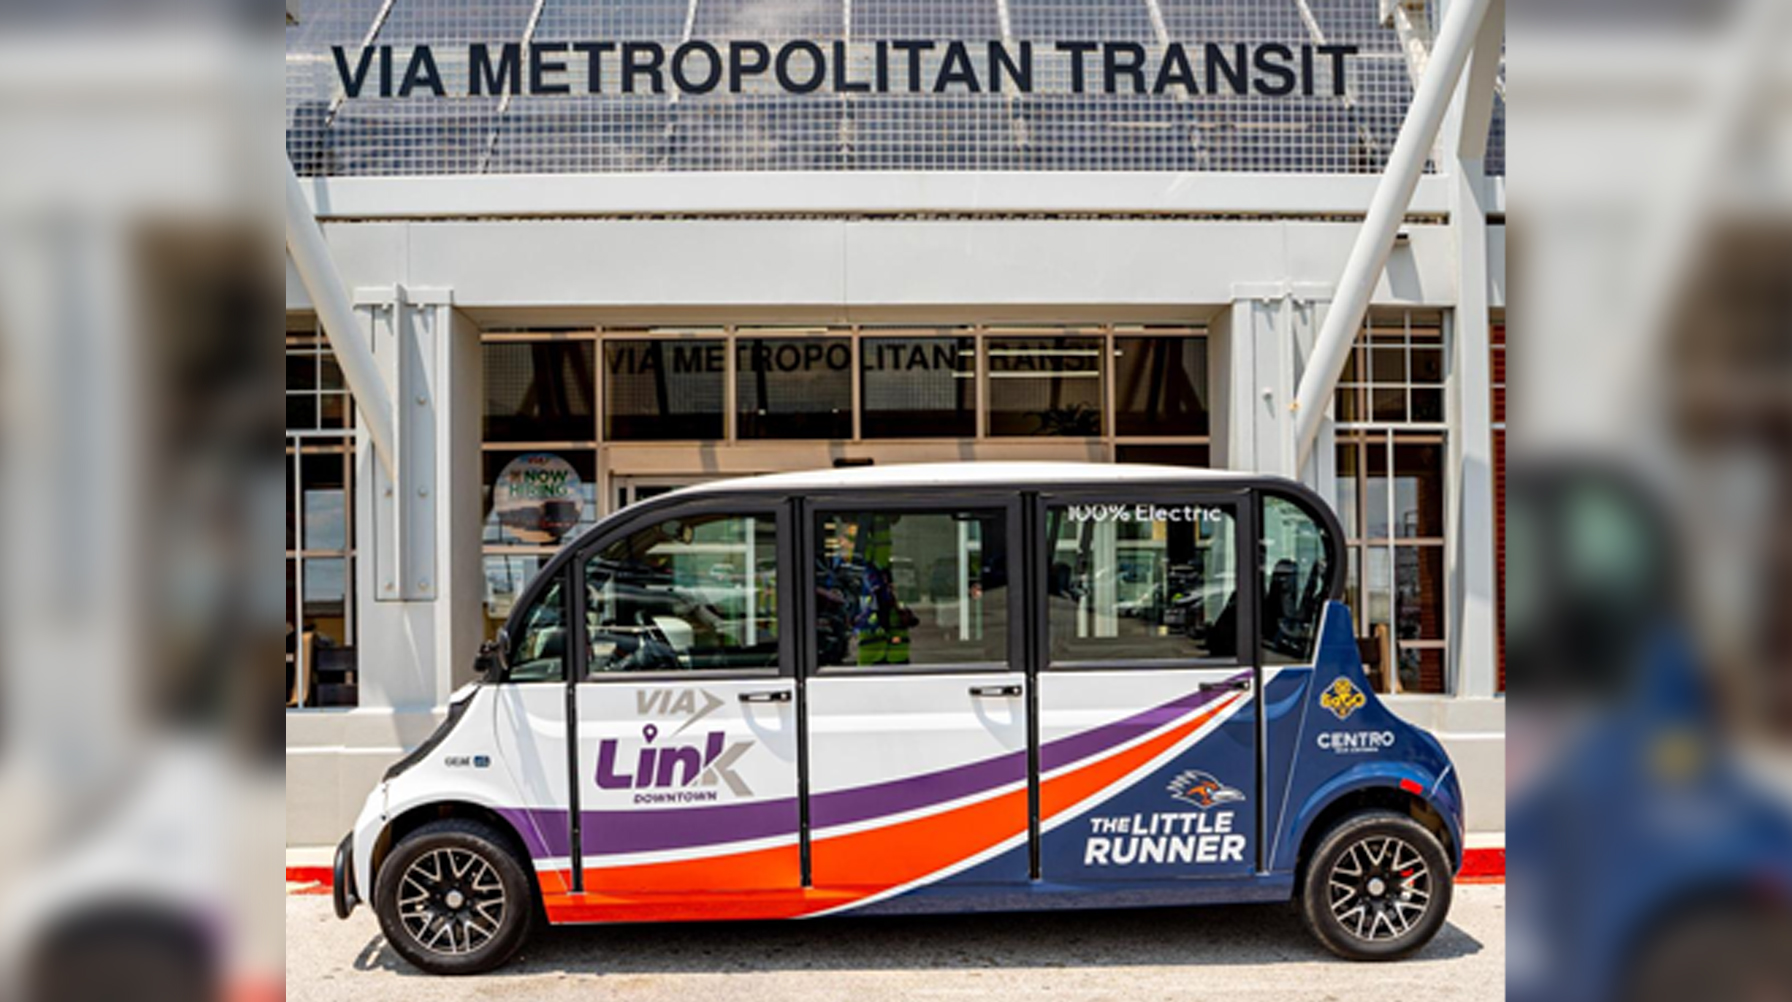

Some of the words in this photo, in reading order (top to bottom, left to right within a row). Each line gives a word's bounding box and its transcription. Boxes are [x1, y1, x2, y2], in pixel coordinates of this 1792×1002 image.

[331, 45, 446, 98] VIA
[468, 40, 1033, 96] METROPOLITAN
[1055, 41, 1359, 97] TRANSIT
[524, 469, 568, 482] NOW
[1067, 503, 1131, 522] 100%
[1135, 503, 1222, 522] Electric
[635, 689, 695, 716] VIA
[1316, 730, 1395, 749] CENTRO
[595, 723, 756, 797] Link
[633, 790, 718, 804] DOWNTOWN
[1090, 816, 1130, 833] THE
[1131, 811, 1234, 834] LITTLE
[1083, 834, 1247, 865] RUNNER
